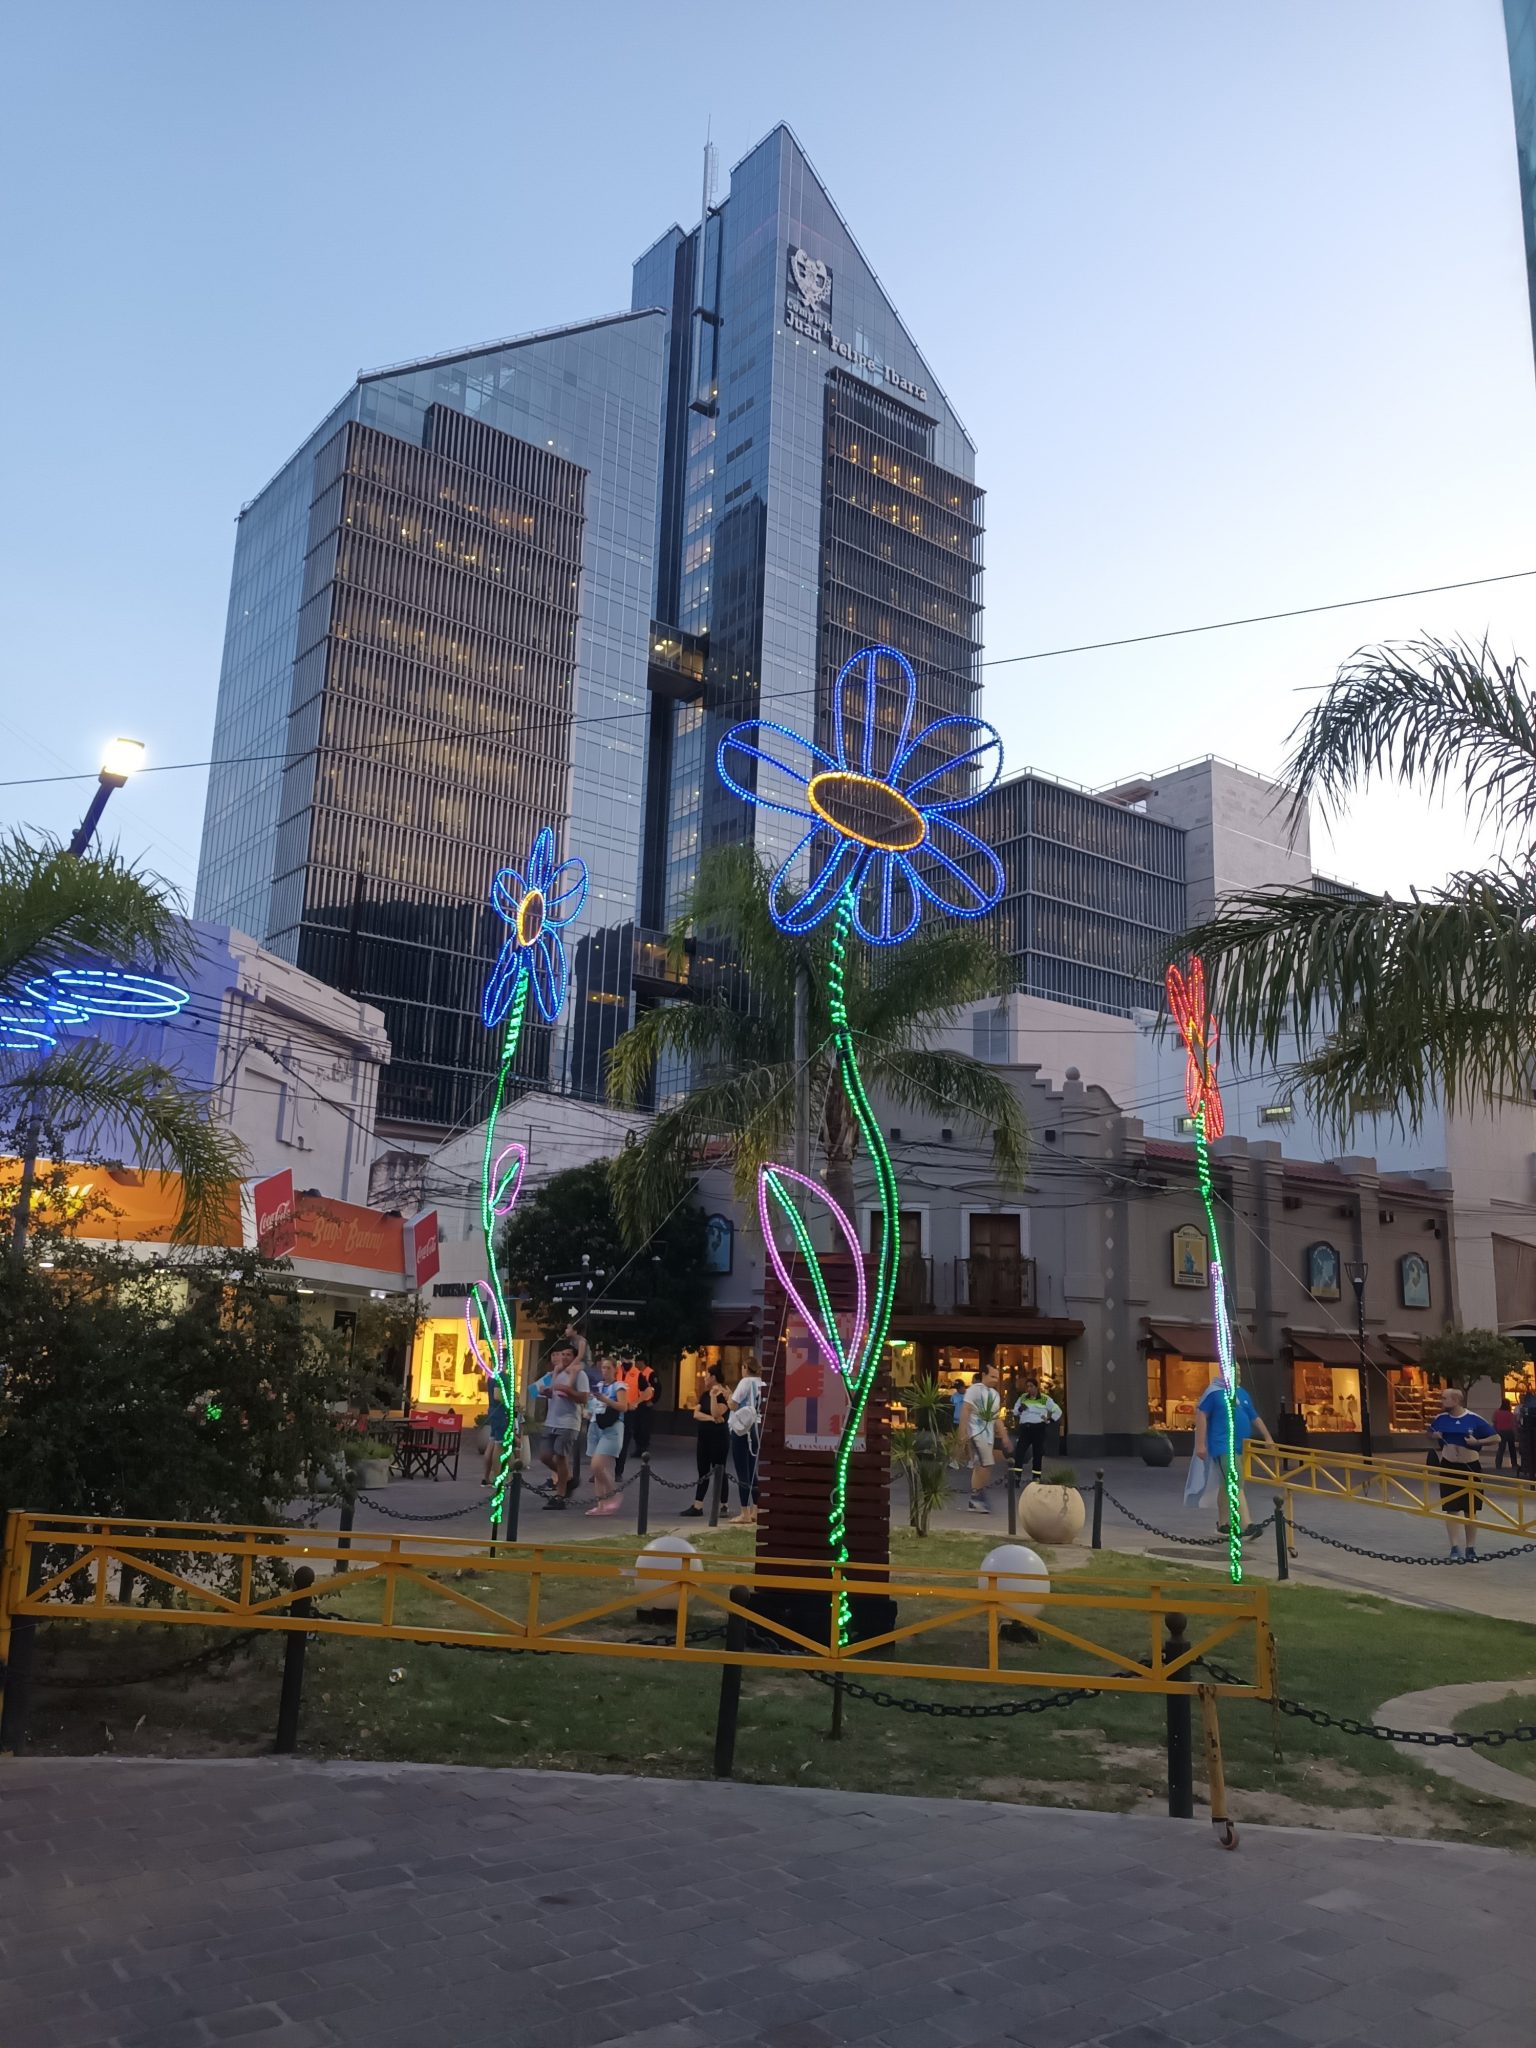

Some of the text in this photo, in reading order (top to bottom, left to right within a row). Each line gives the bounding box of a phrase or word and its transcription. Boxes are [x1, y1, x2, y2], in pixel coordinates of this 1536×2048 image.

[786, 297, 833, 331] Complejo
[786, 310, 928, 400] Juan Felipe Ibarra
[344, 1217, 385, 1256] Bunny
